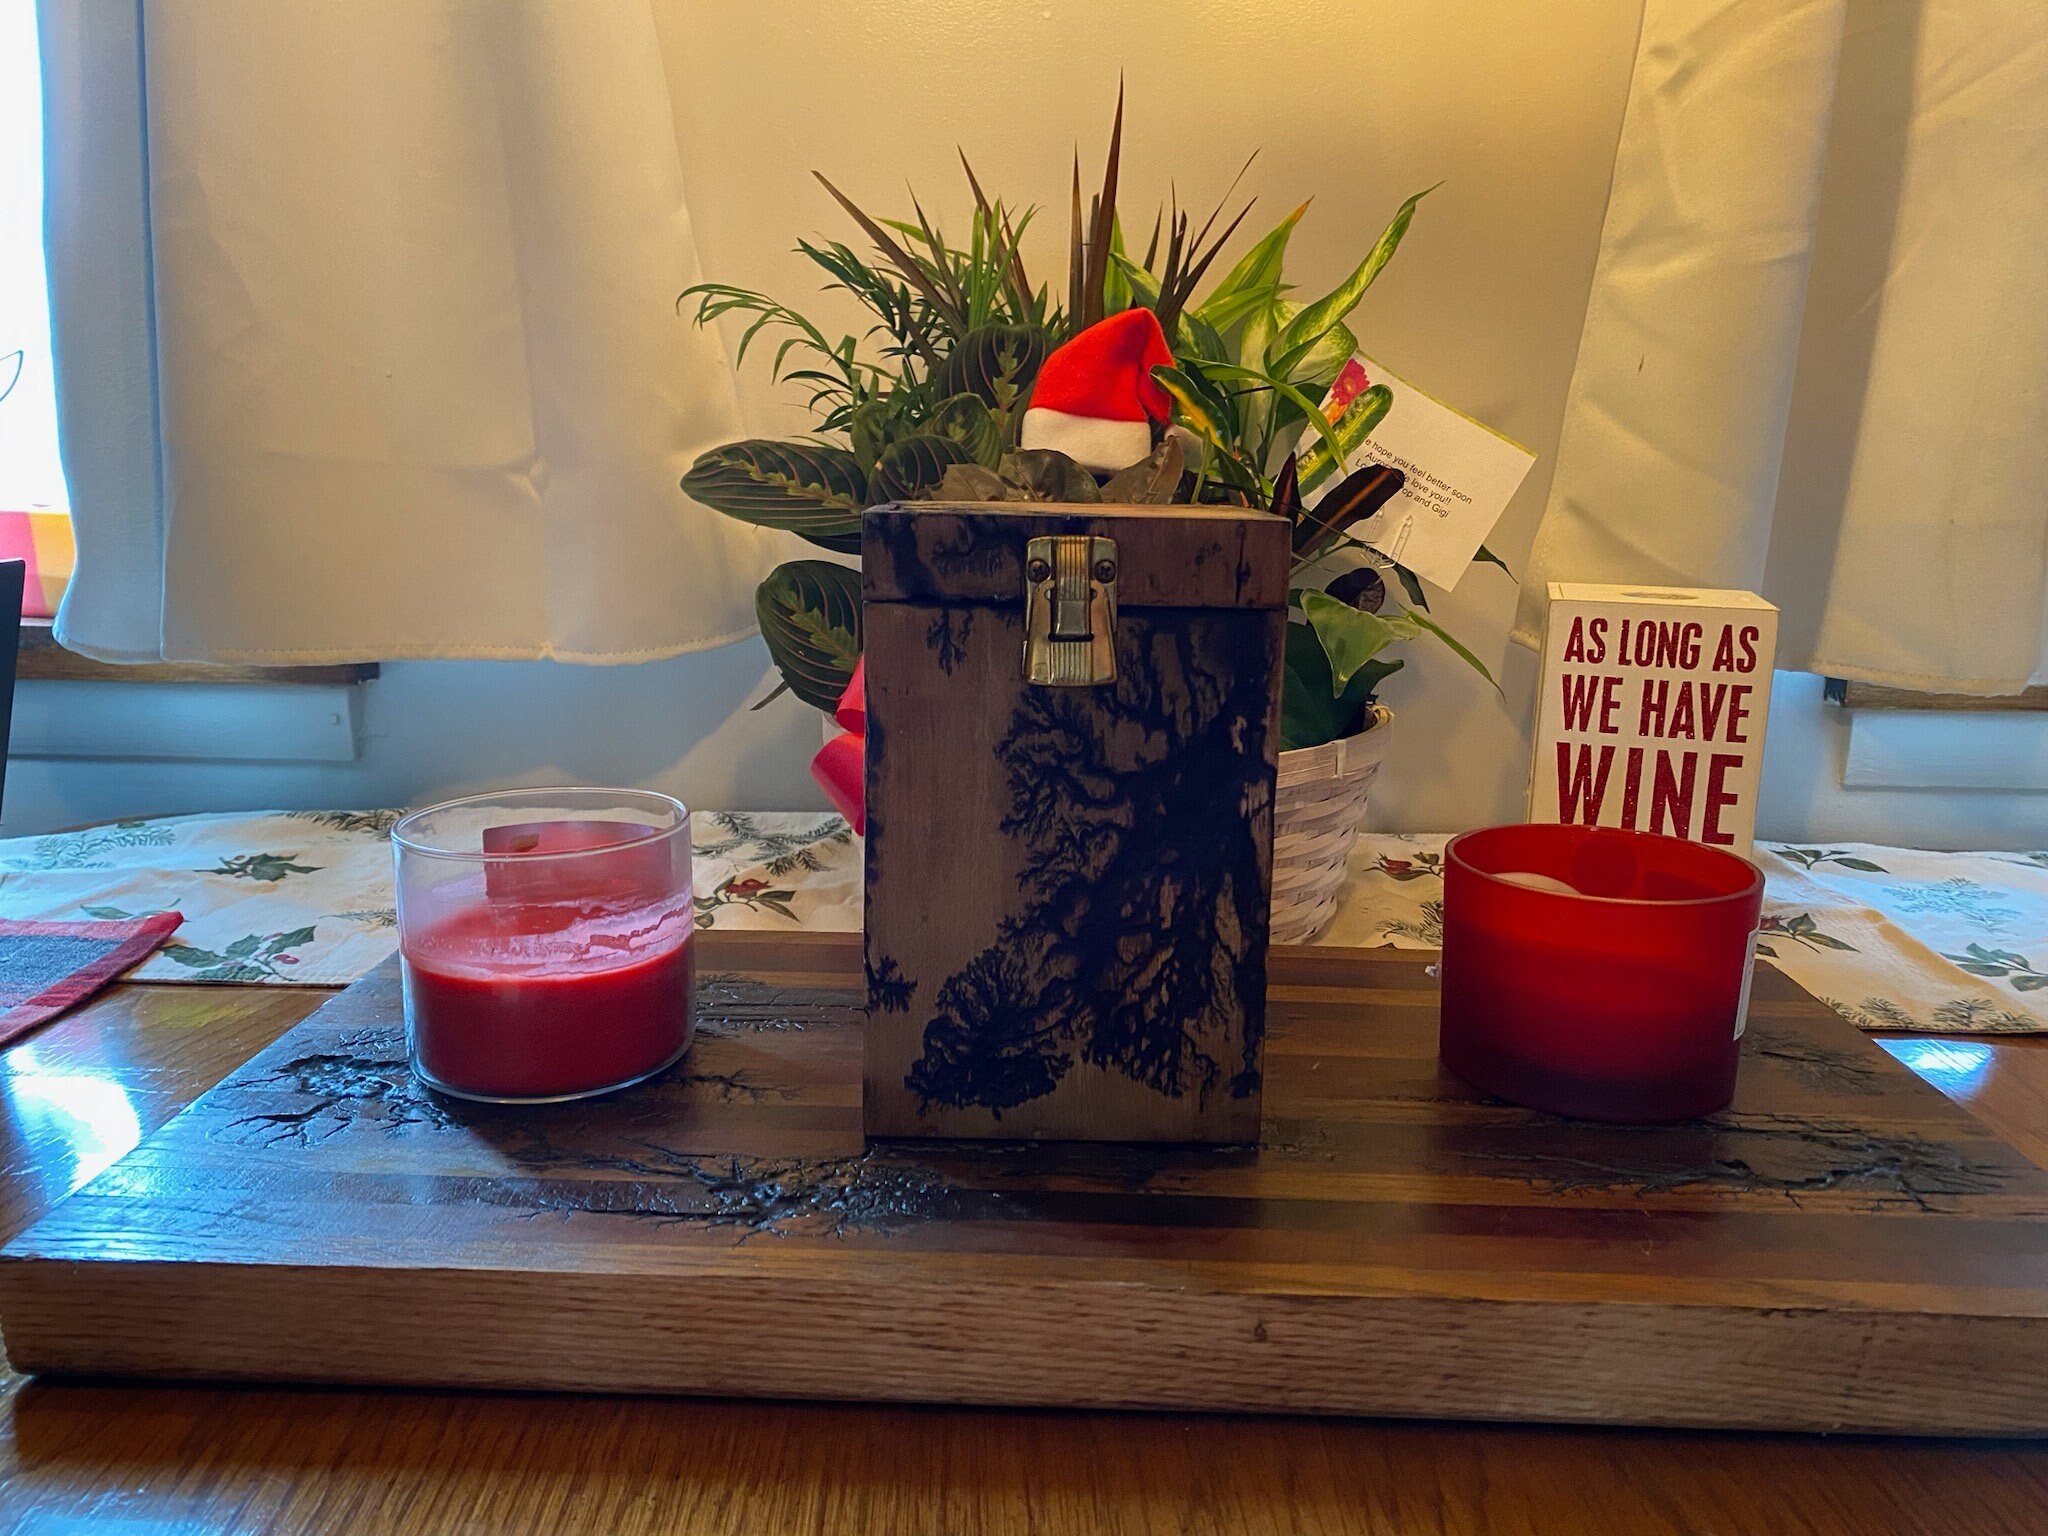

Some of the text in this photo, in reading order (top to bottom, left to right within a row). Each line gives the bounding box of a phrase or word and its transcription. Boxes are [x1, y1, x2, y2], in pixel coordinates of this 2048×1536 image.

[1371, 441, 1393, 459] hope
[1392, 455, 1410, 469] you
[1409, 464, 1427, 477] feel
[1425, 473, 1451, 492] better
[1451, 489, 1473, 505] soon
[1410, 479, 1429, 494] love
[1428, 490, 1452, 505] you!!
[1413, 495, 1432, 508] and
[1431, 503, 1451, 519] Gigi
[1563, 616, 1760, 674] AS LONG AS
[1562, 673, 1753, 743] WE HAVE
[1556, 741, 1744, 846] WINE
